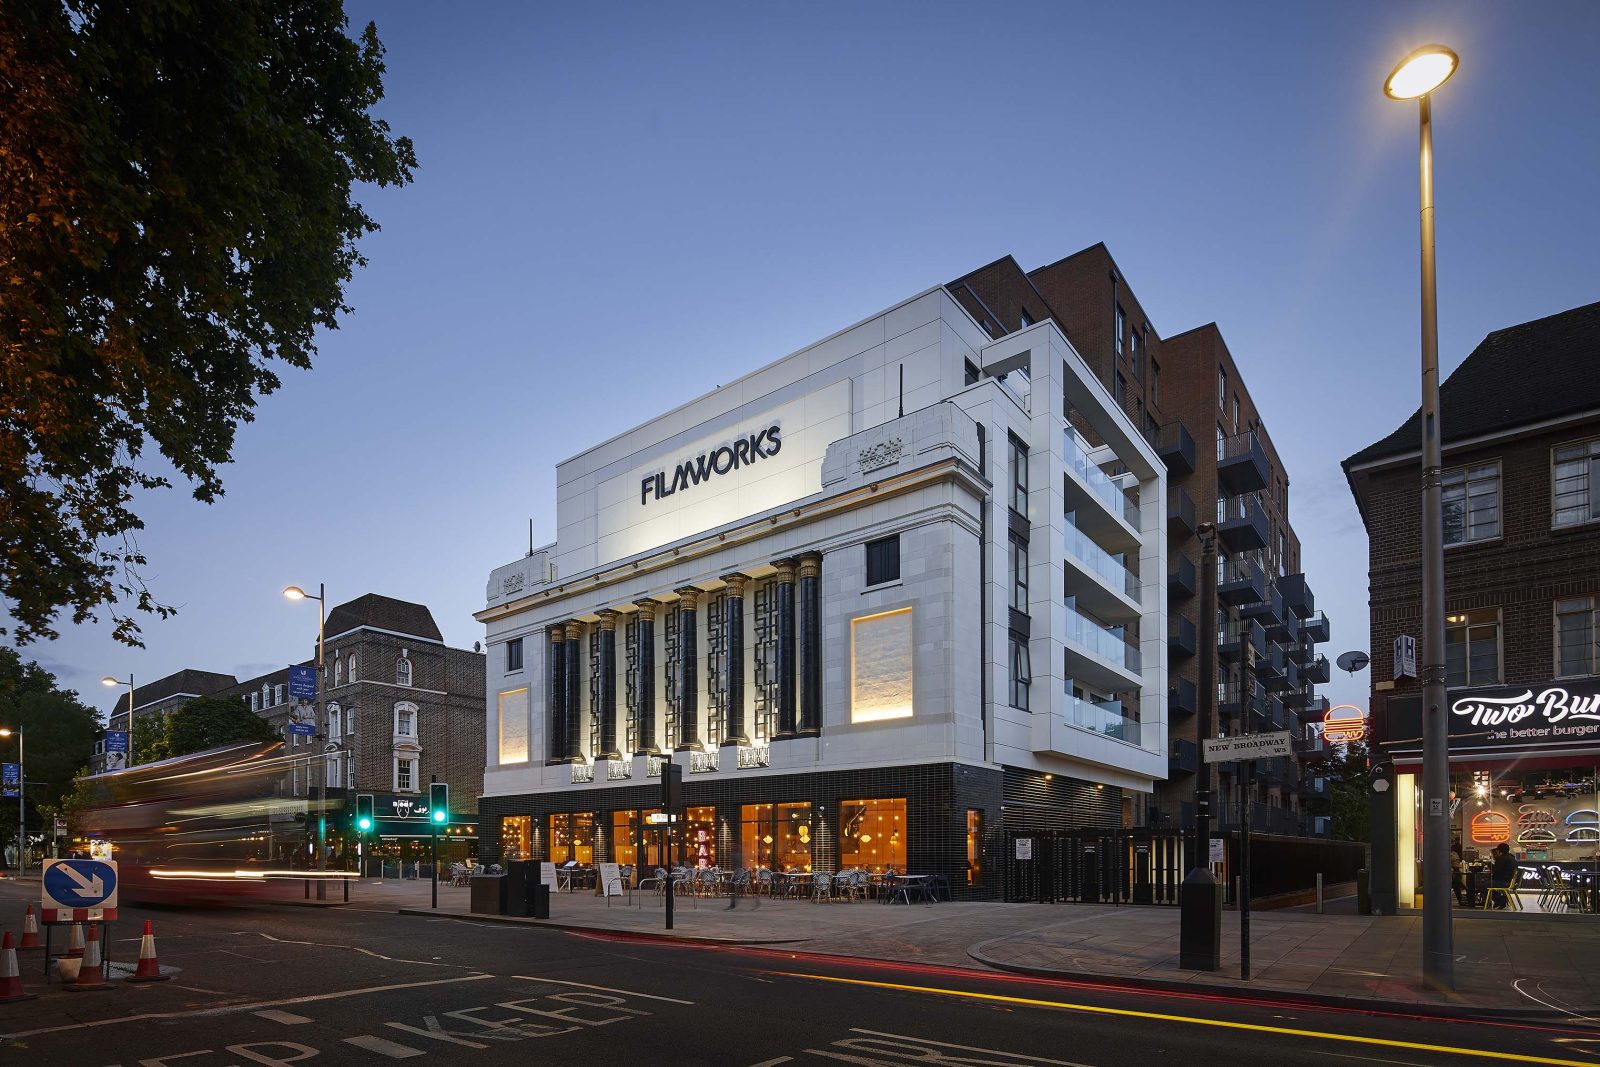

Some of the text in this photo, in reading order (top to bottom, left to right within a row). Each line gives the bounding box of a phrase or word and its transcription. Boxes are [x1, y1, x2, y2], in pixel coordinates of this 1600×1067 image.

[641, 425, 782, 505] FILMWORKS
[1452, 689, 1535, 725] Two
[1510, 727, 1550, 738] better
[1553, 724, 1599, 736] burger
[1208, 738, 1285, 752] NEW BROADWAY
